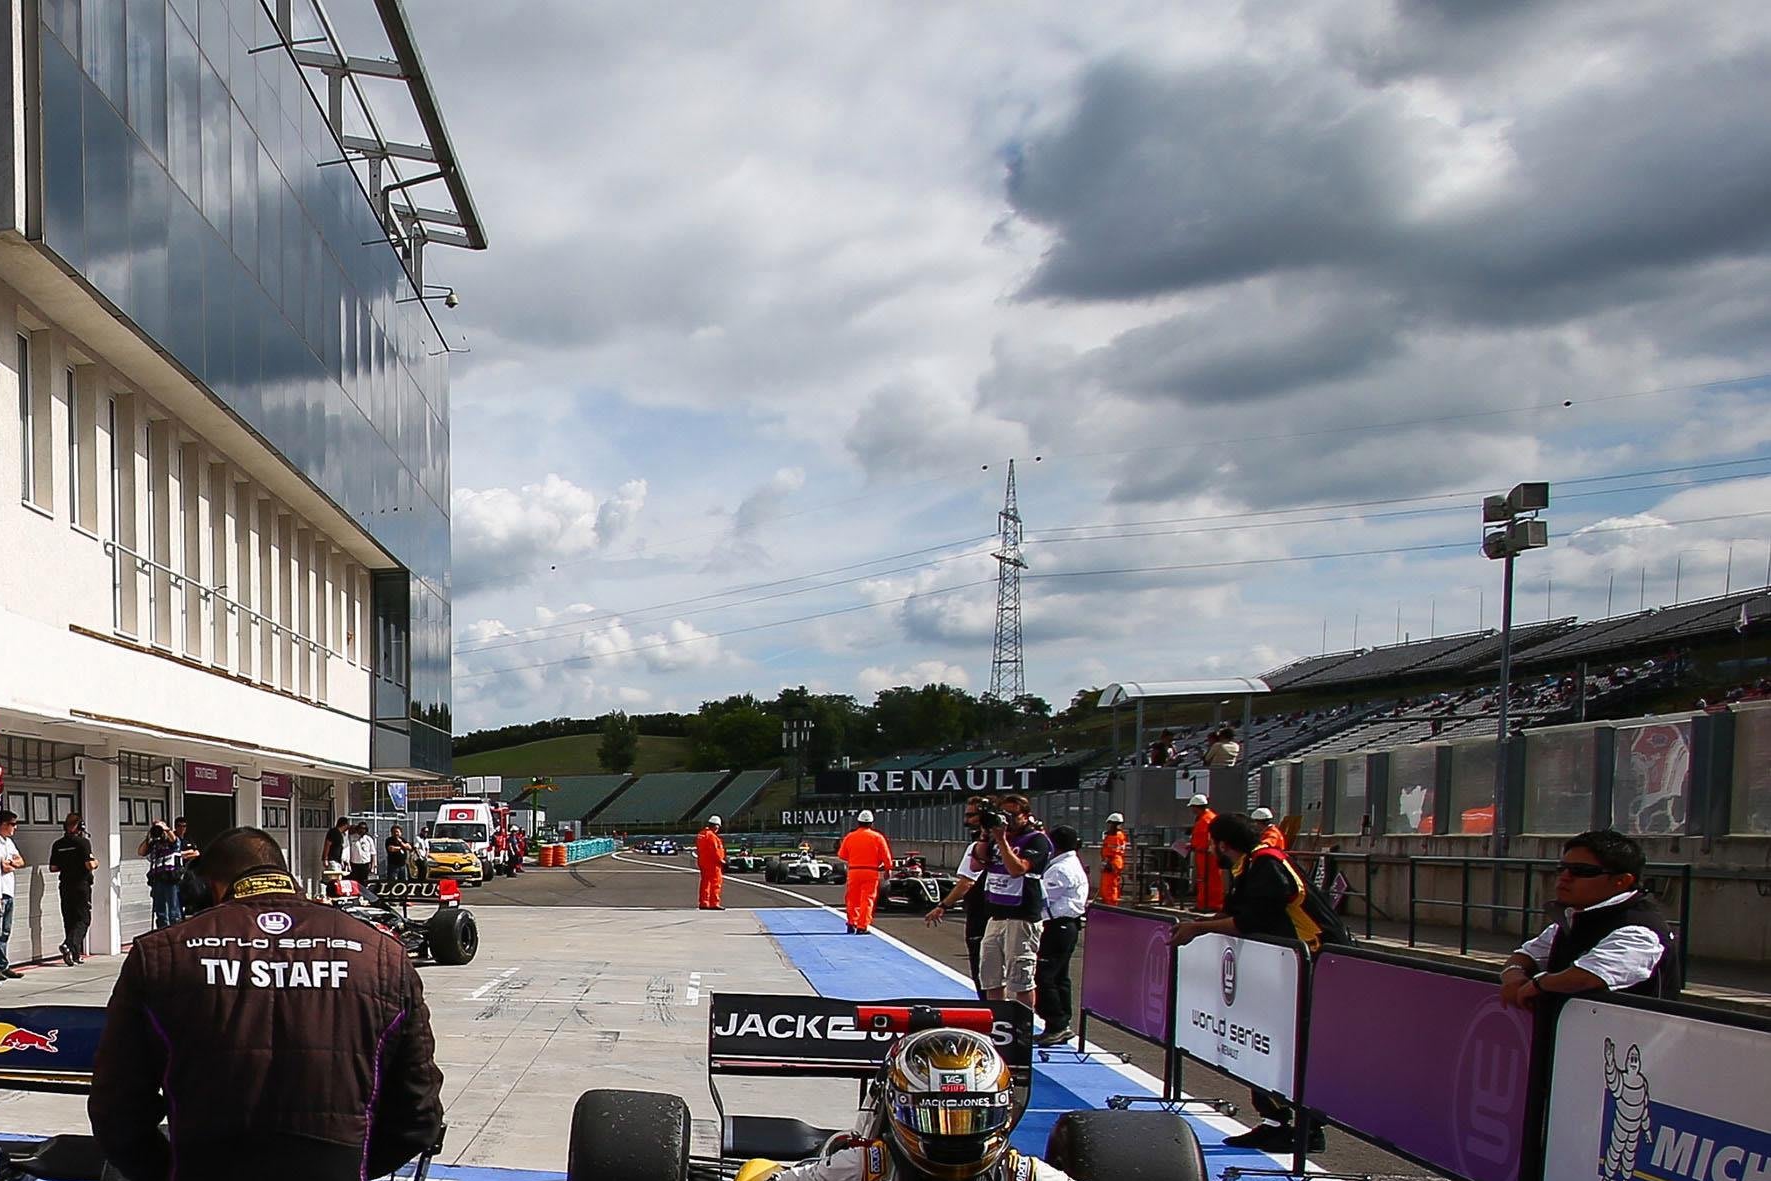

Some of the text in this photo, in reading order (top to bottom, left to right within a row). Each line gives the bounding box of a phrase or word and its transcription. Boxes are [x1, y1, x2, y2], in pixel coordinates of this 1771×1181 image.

[857, 768, 1038, 793] RENAULT
[185, 937, 364, 952] world series
[200, 958, 349, 989] TV STAFF
[715, 1012, 820, 1040] JACK
[1191, 1009, 1271, 1055] world series
[944, 1075, 963, 1084] TAG
[957, 1097, 990, 1108] JONES
